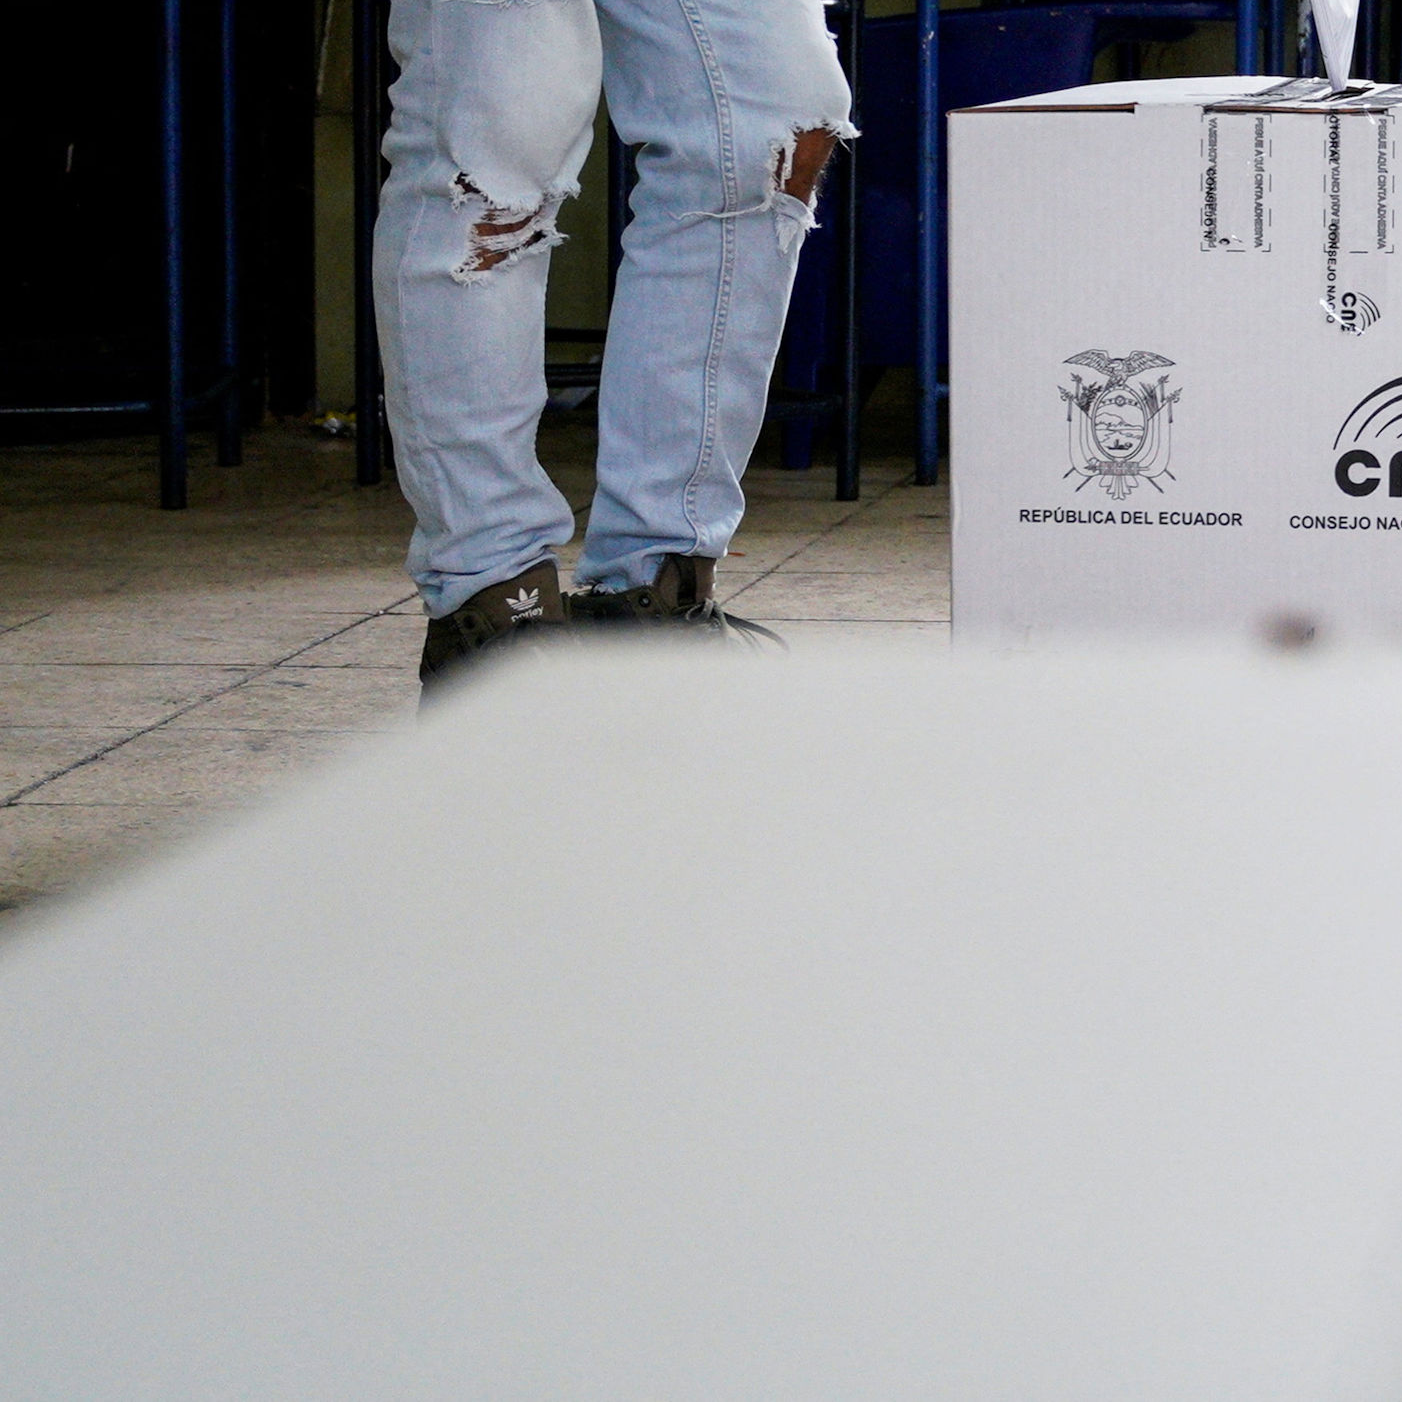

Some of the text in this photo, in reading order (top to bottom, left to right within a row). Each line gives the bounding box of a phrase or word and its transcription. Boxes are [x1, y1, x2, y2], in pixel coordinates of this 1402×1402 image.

[1328, 112, 1339, 165] CTORAL
[1327, 223, 1338, 281] CONSEJO
[1019, 506, 1243, 526] REPÚBLICA DEL ECUADOR
[1289, 515, 1371, 530] CONSEJO
